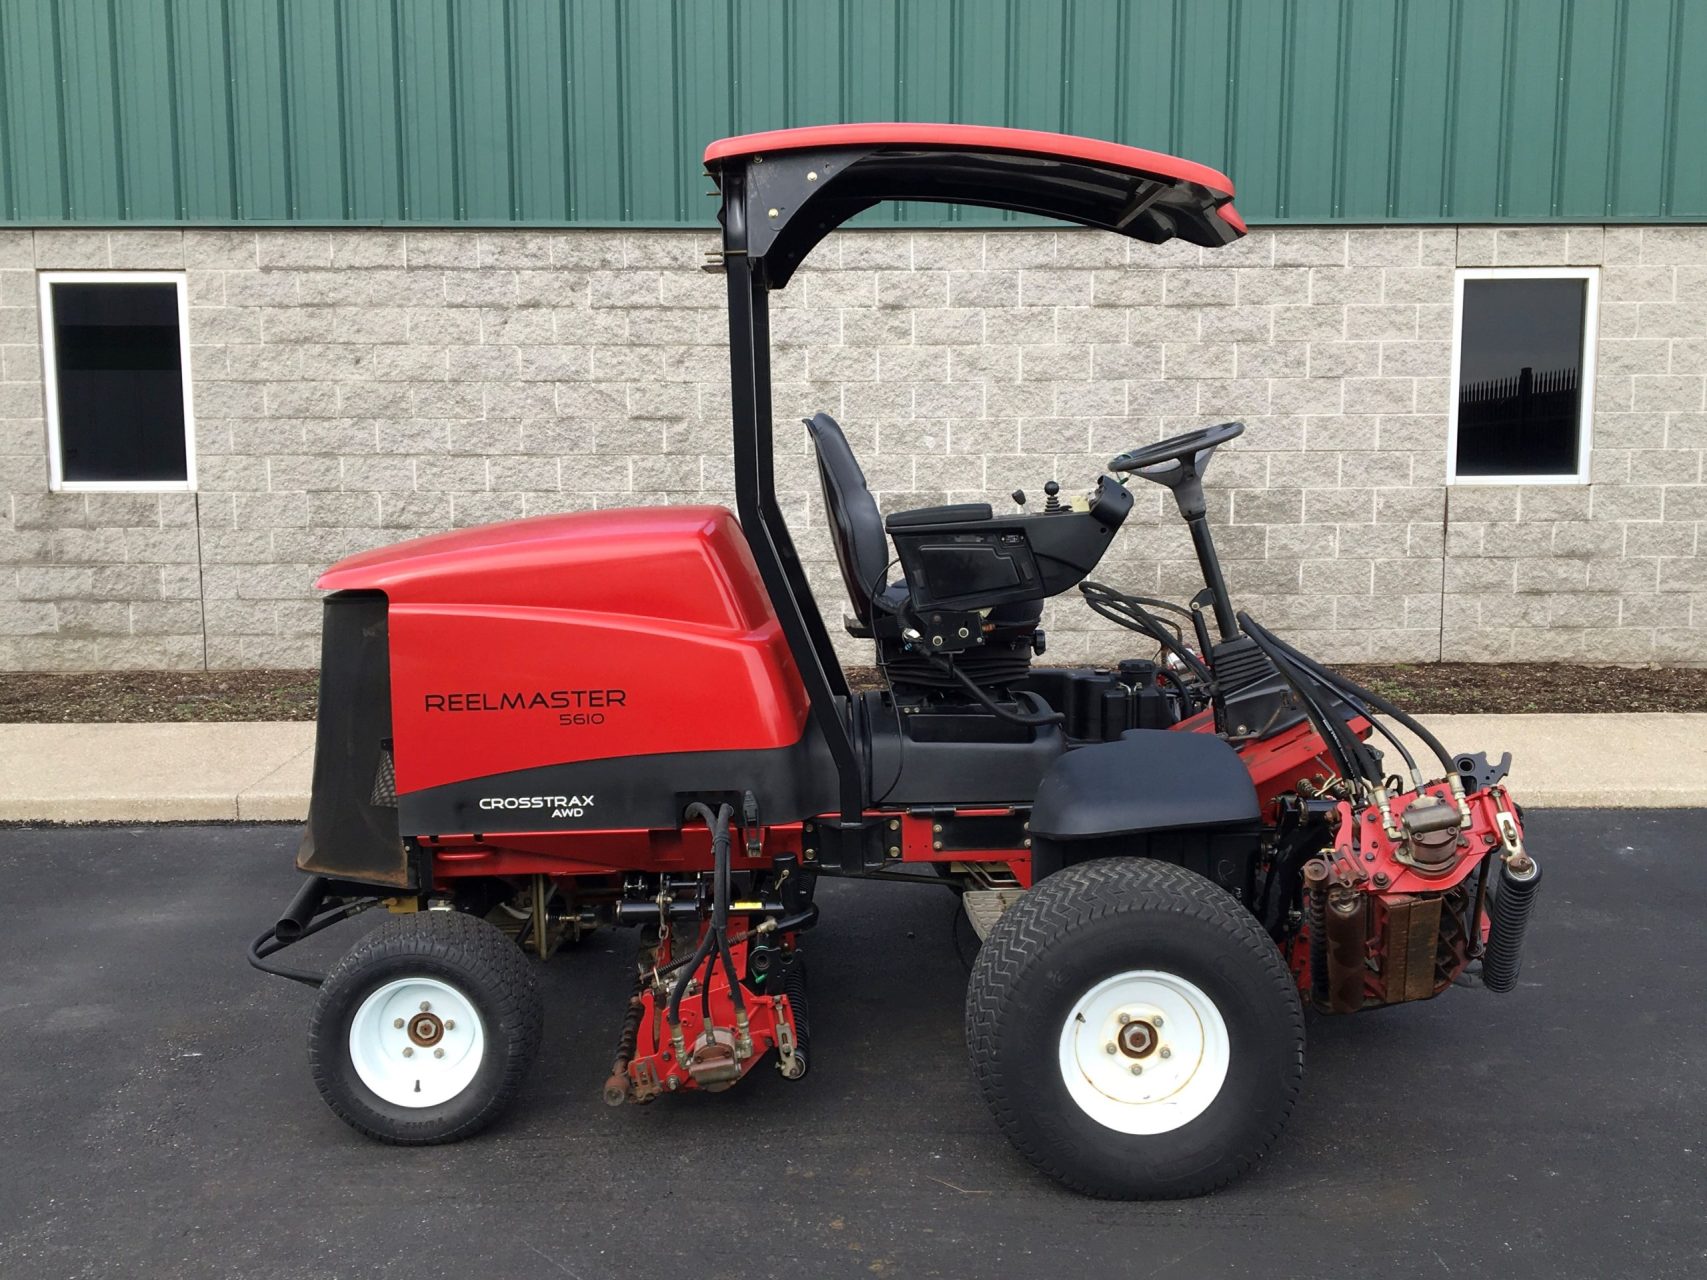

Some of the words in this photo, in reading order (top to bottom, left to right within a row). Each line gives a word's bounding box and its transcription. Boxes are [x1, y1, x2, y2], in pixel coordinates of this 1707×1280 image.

[425, 689, 627, 713] REELMASTER
[559, 713, 605, 726] 5610
[478, 795, 595, 810] CROSSTRAX
[551, 808, 584, 818] AWD
